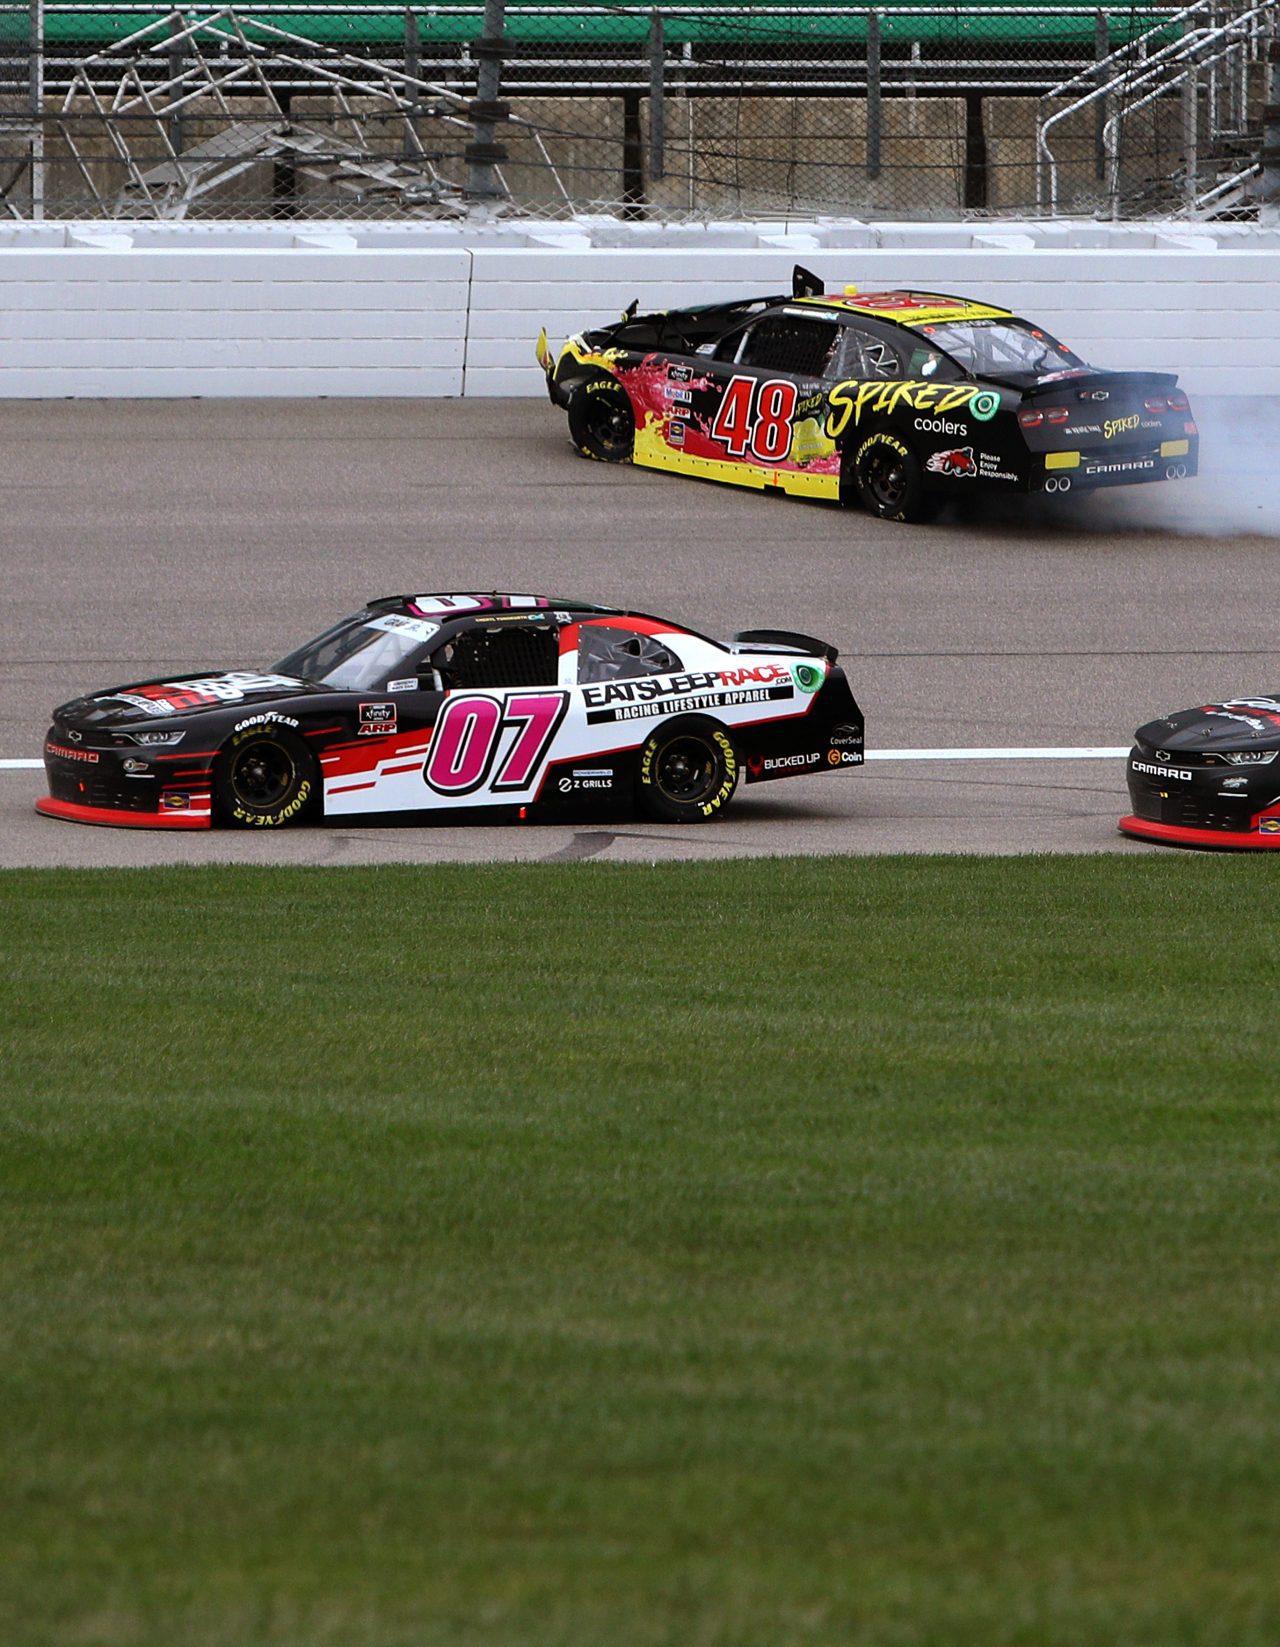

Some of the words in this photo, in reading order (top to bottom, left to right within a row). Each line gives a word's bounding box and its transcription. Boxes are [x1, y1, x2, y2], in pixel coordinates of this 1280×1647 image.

[586, 381, 622, 394] EAGLE
[711, 374, 798, 461] 48
[827, 379, 980, 438] SPIKED
[914, 417, 968, 437] coolers
[1103, 414, 1140, 439] SPIKED
[856, 432, 909, 465] GOODYEAR
[980, 452, 1001, 462] Please
[980, 461, 998, 471] Enjoy
[1086, 460, 1155, 475] CAMARO
[580, 663, 791, 708] EATSLEEPRACE
[365, 709, 392, 721] xfinity
[614, 704, 660, 721] RACING
[663, 694, 721, 715] LIFESTYLE
[724, 689, 771, 705] APPAREL
[233, 710, 300, 733] GOODYEAR
[359, 723, 397, 735] ARP
[425, 692, 570, 796] 07
[830, 736, 863, 746] CoverSeal
[46, 743, 100, 764] CAMARO
[642, 738, 658, 785] EAGLE
[764, 755, 805, 770] BUCKED
[806, 752, 821, 764] UP
[841, 751, 863, 762] Coin
[701, 730, 736, 817] GOODYEAR
[1131, 760, 1193, 782] CAMARO
[573, 780, 581, 789] Z
[582, 778, 613, 789] GRILLS
[233, 780, 312, 826] GOODYEAR
